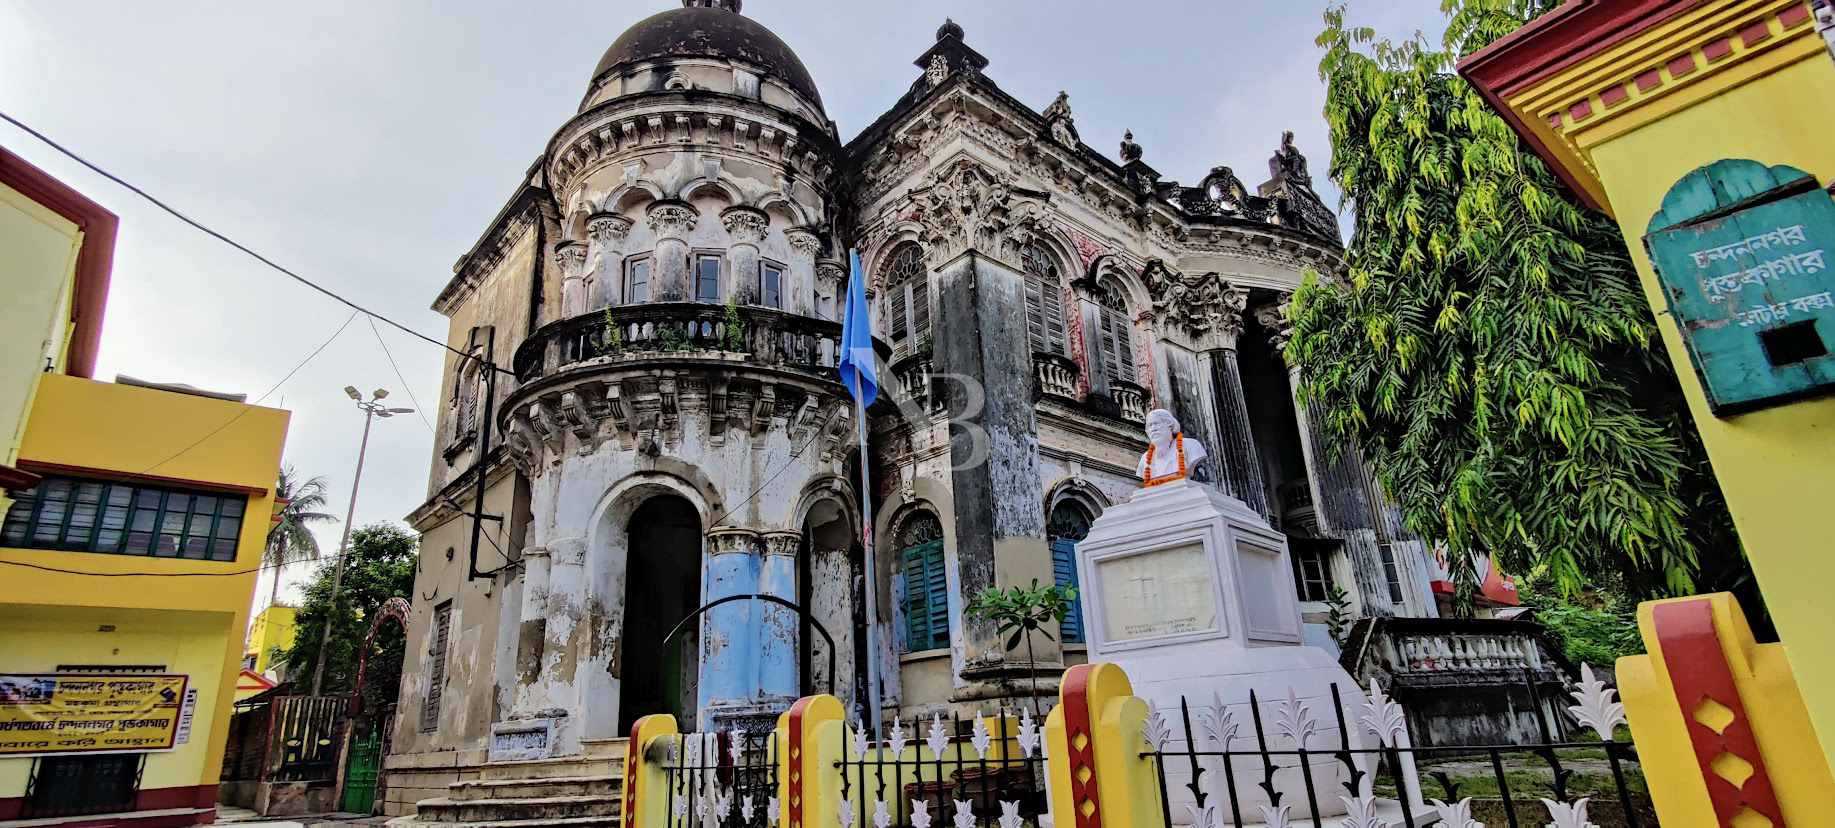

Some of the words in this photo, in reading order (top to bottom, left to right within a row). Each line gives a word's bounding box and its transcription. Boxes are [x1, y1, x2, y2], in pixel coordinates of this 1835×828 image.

[1689, 225, 1806, 269] চন্দননগর
[1703, 249, 1826, 303] পুস্তকাগার
[58, 719, 114, 732] চন্দননগর
[118, 718, 170, 732] পুস্তকাগার
